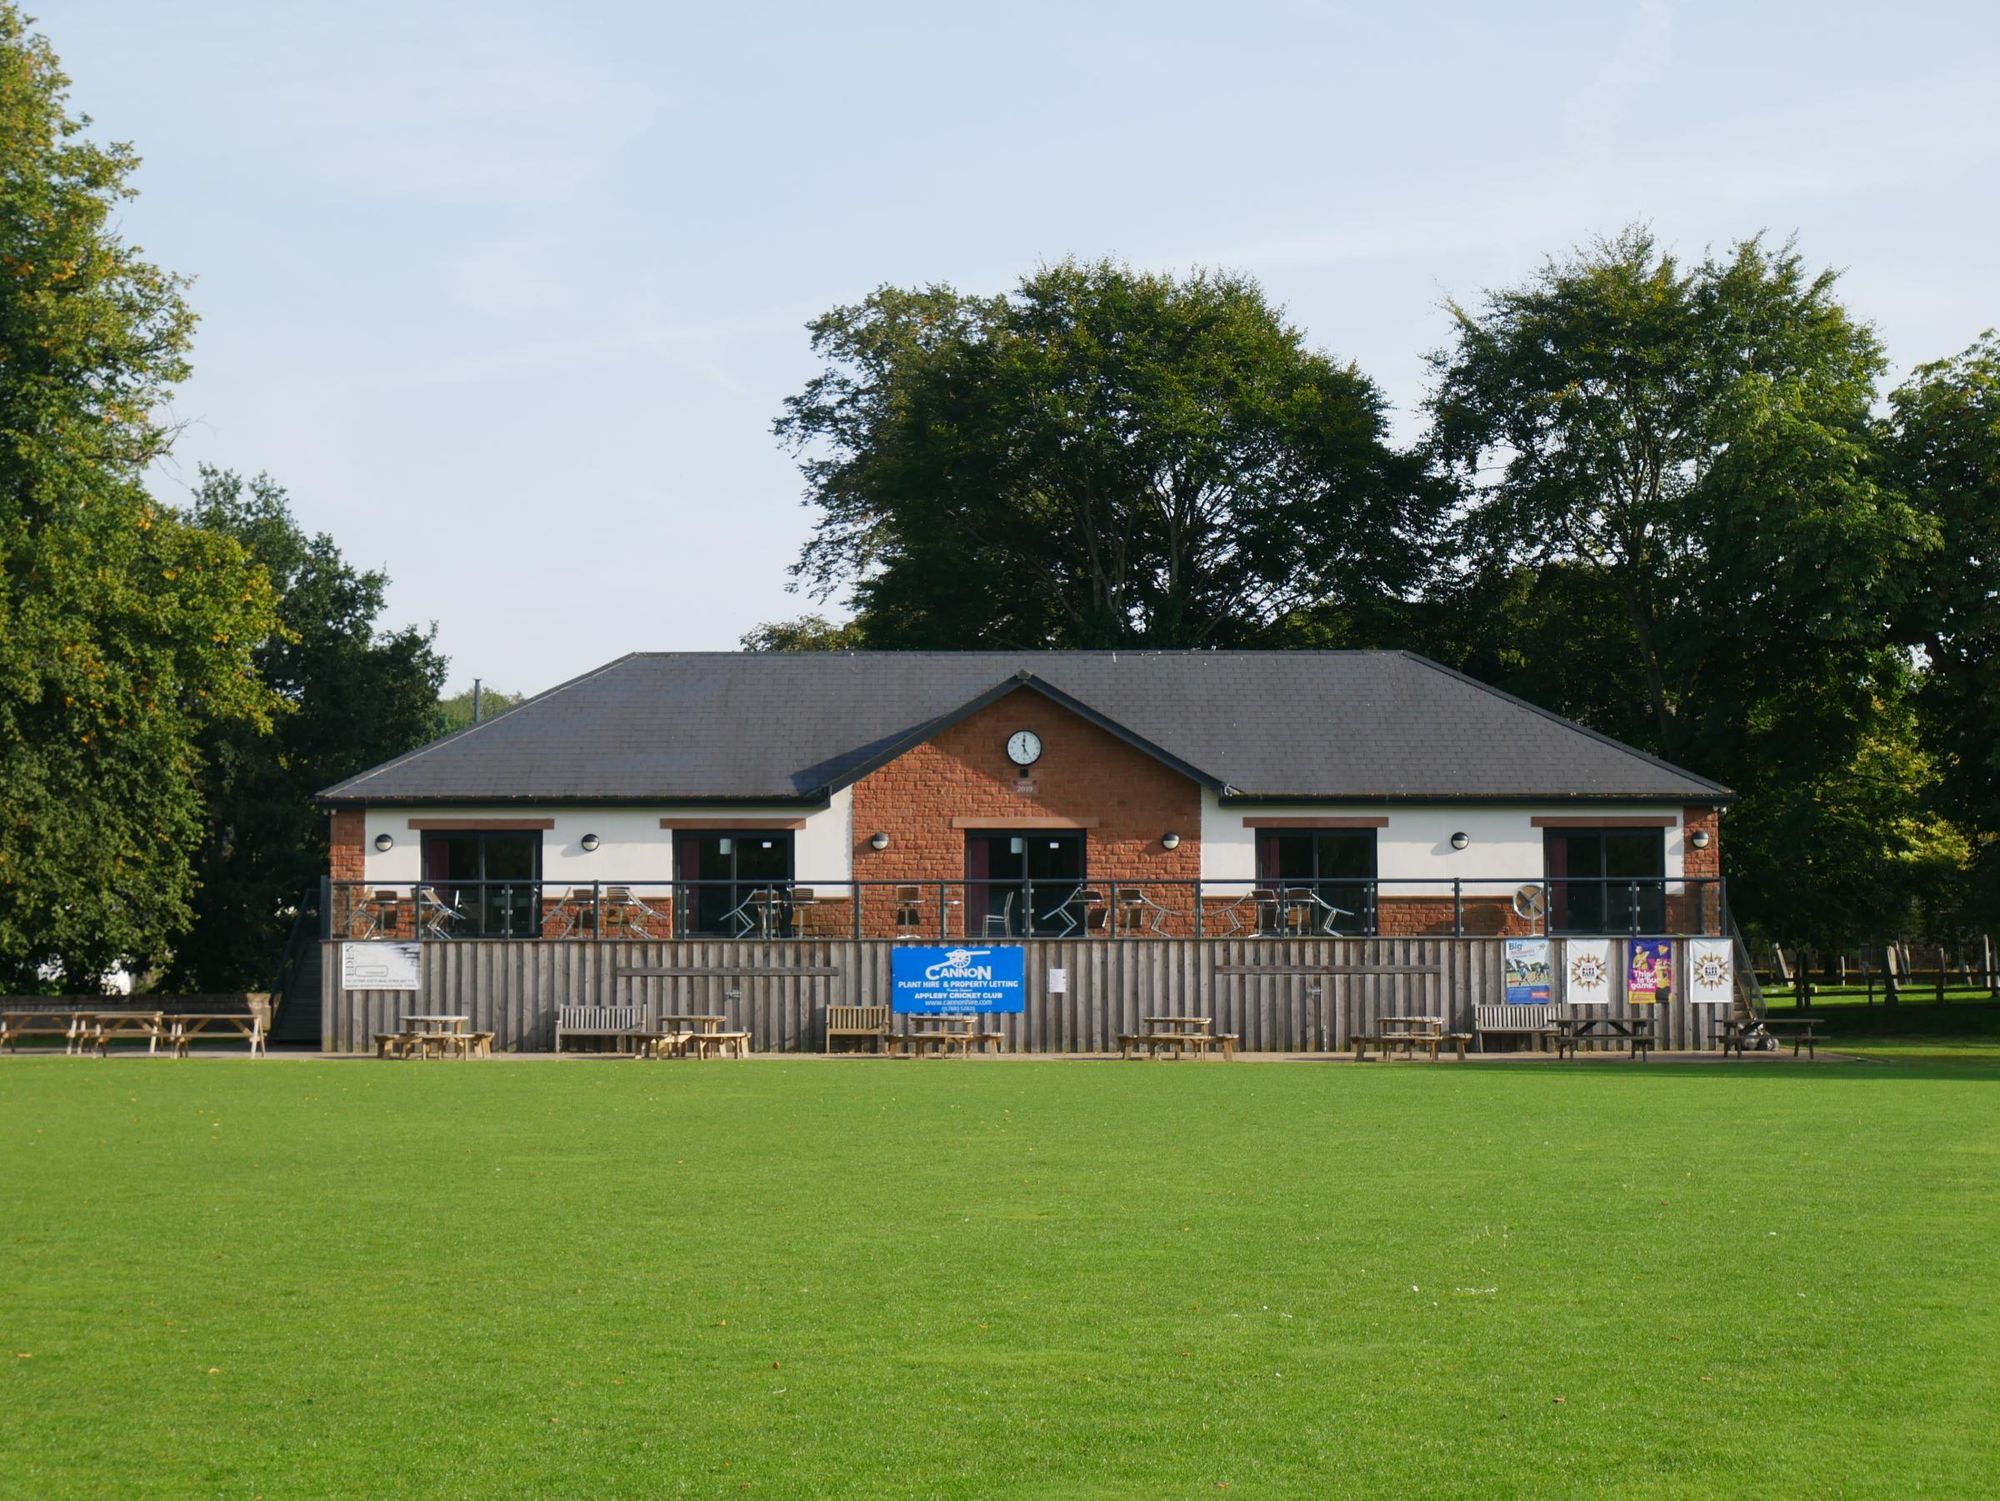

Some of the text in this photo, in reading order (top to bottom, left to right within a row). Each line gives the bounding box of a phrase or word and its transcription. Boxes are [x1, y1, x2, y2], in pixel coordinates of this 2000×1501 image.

[345, 945, 355, 976] EDEN
[925, 965, 992, 981] CANNON
[989, 980, 1019, 988] LETTING
